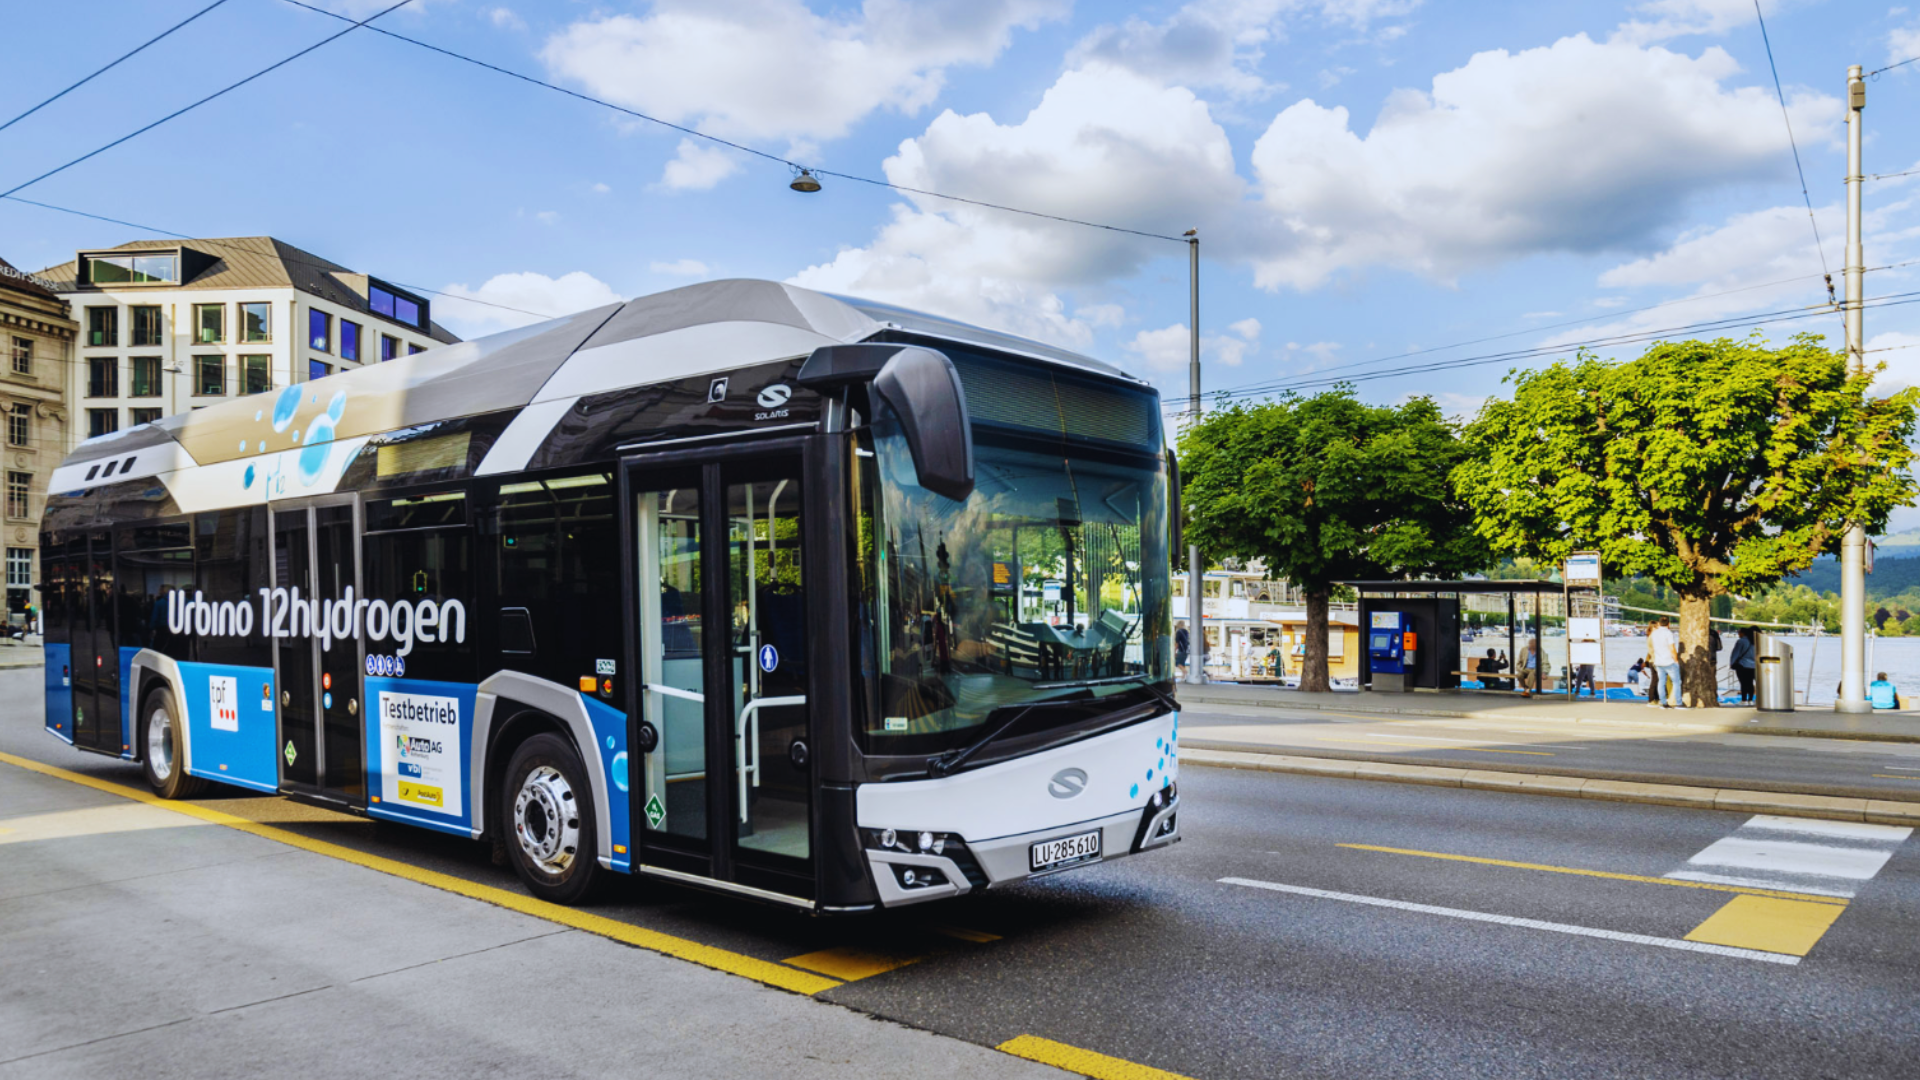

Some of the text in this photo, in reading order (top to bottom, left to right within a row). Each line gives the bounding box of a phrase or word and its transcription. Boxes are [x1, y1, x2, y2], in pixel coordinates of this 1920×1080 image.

[754, 409, 789, 421] SOLARIS
[168, 589, 254, 637] Urbino
[211, 680, 226, 709] tpf
[382, 697, 457, 725] Testbetrieb
[410, 738, 443, 754] Auto AG
